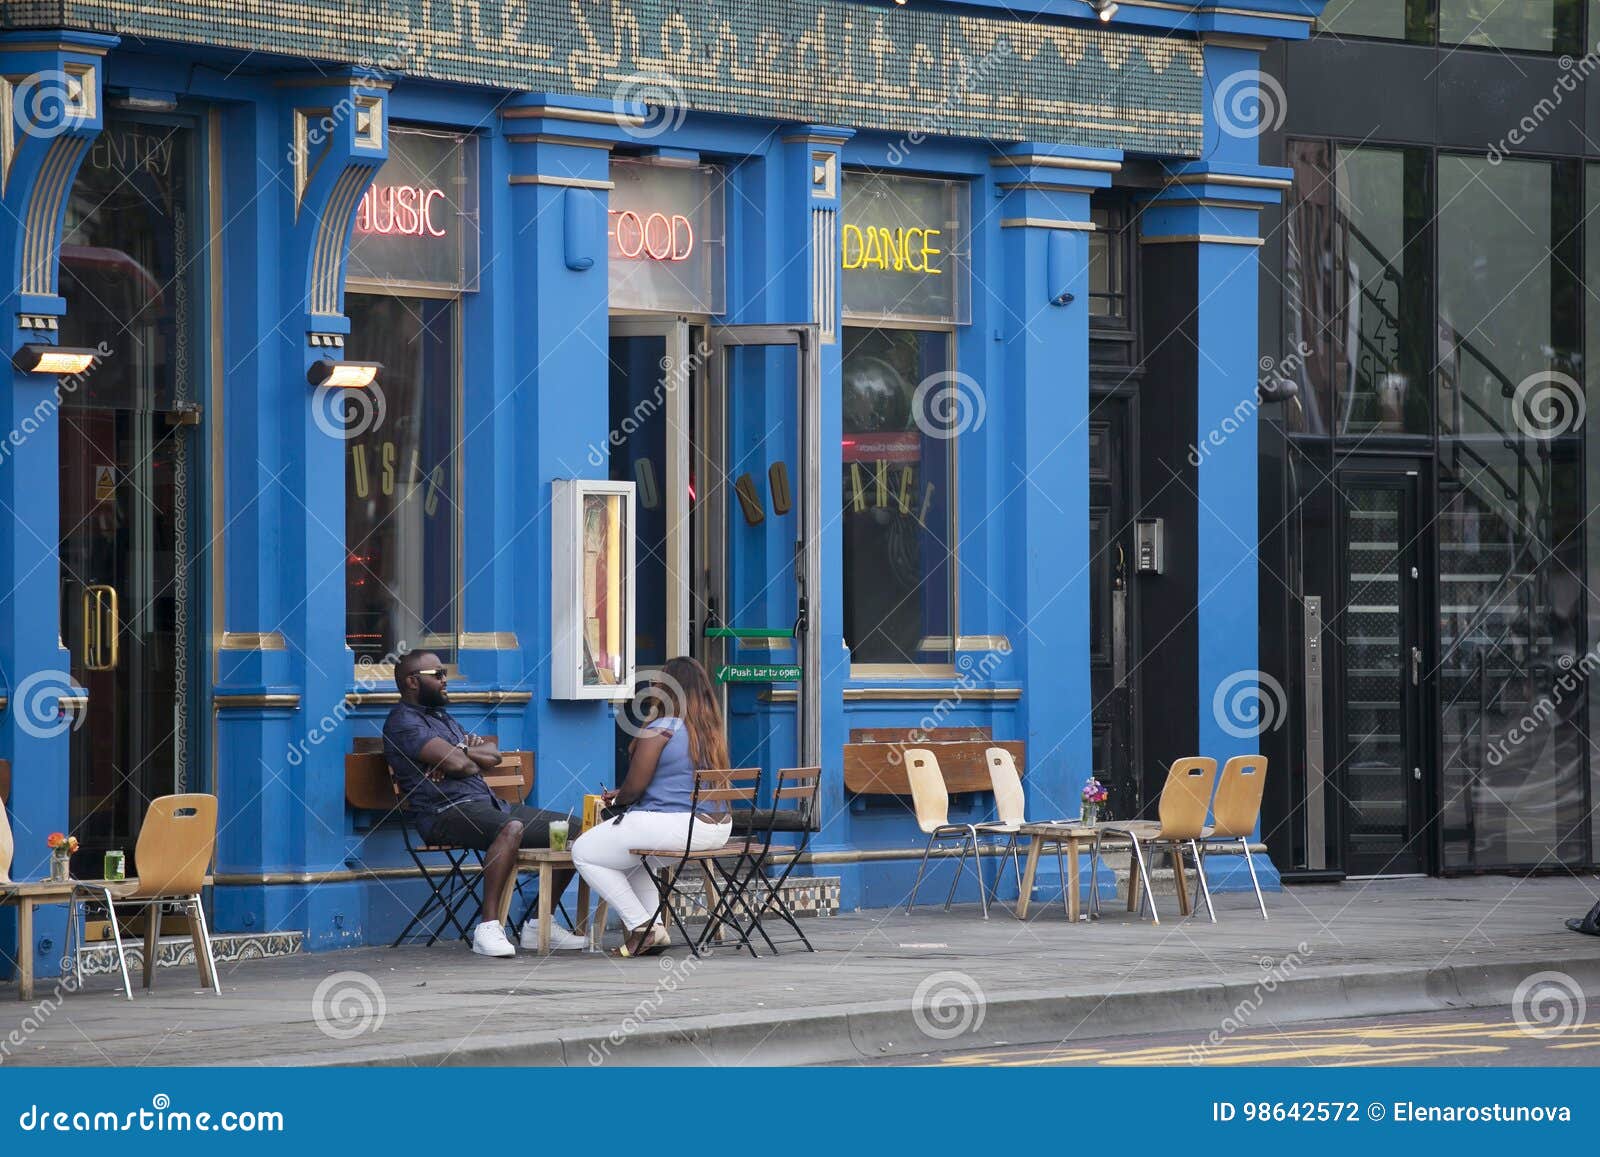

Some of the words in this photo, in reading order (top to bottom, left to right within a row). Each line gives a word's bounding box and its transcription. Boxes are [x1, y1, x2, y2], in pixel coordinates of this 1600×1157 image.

[842, 224, 942, 274] DANCE
[352, 441, 445, 516] USIC
[730, 668, 752, 677] Push
[779, 669, 800, 679] open
